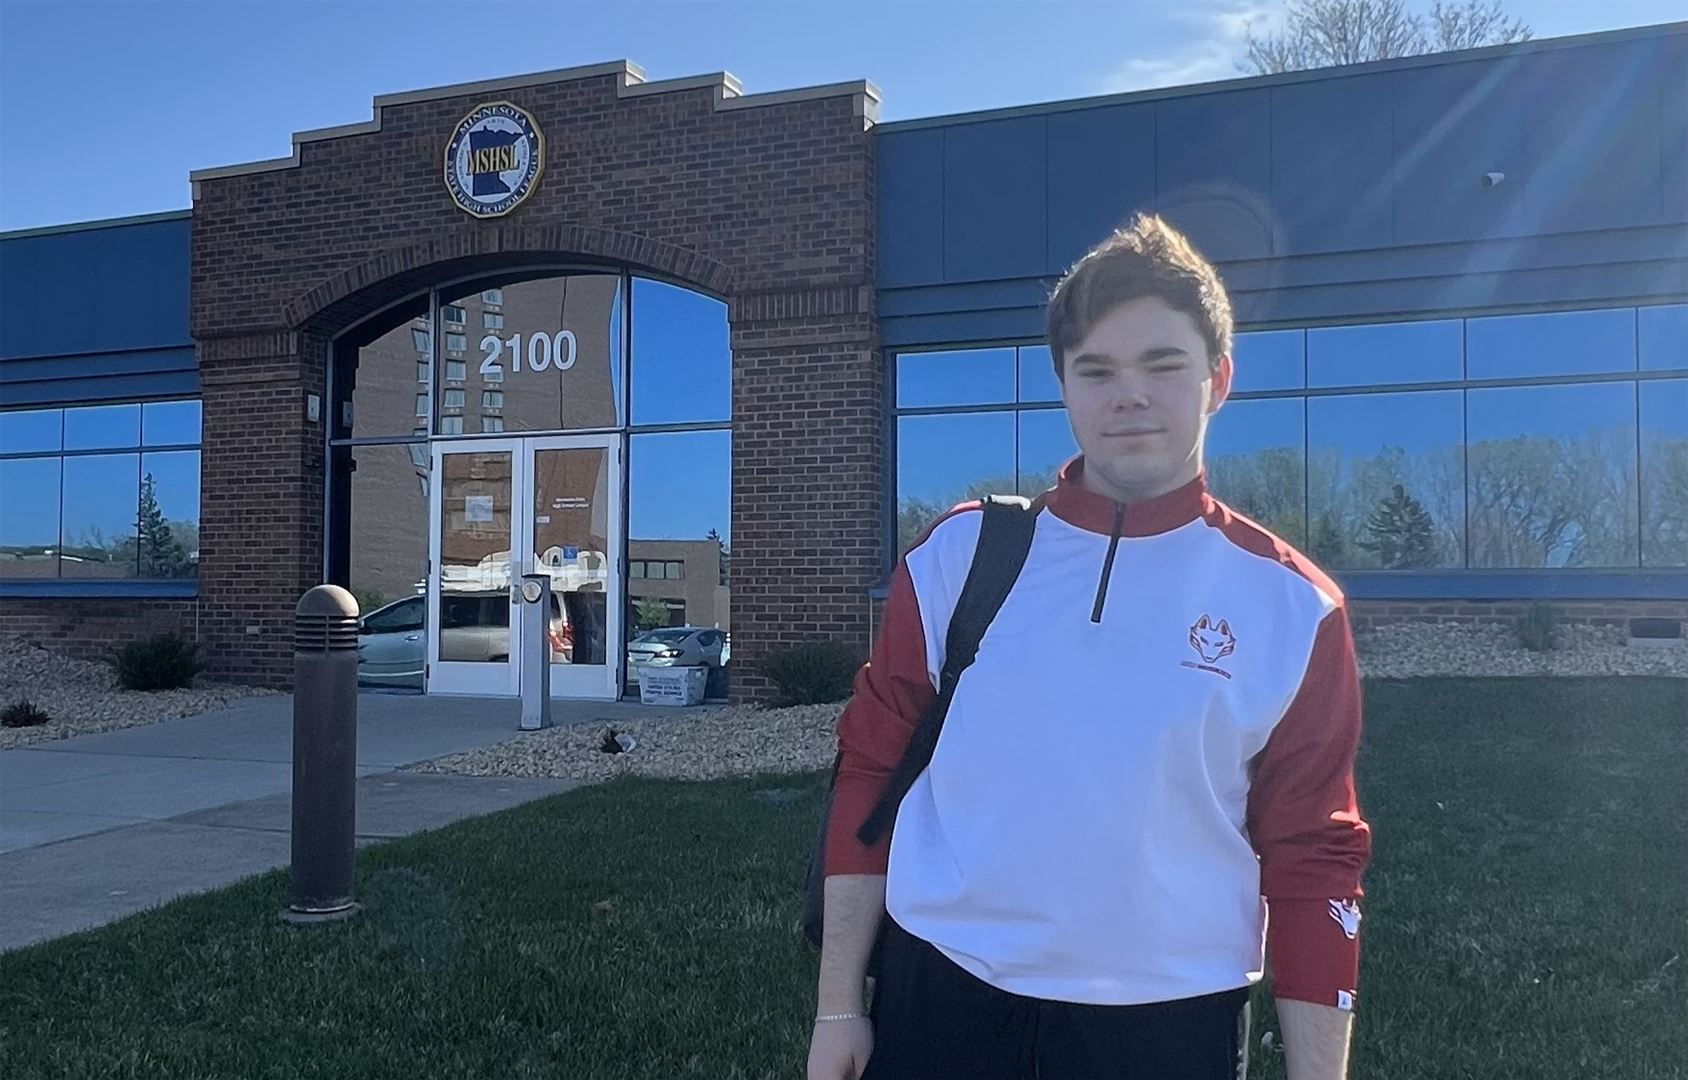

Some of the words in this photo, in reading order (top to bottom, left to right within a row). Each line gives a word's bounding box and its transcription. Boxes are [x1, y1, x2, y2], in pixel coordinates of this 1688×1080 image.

[460, 106, 527, 134] MINNESOTA
[465, 145, 520, 175] MSHSL
[480, 330, 577, 373] 2100
